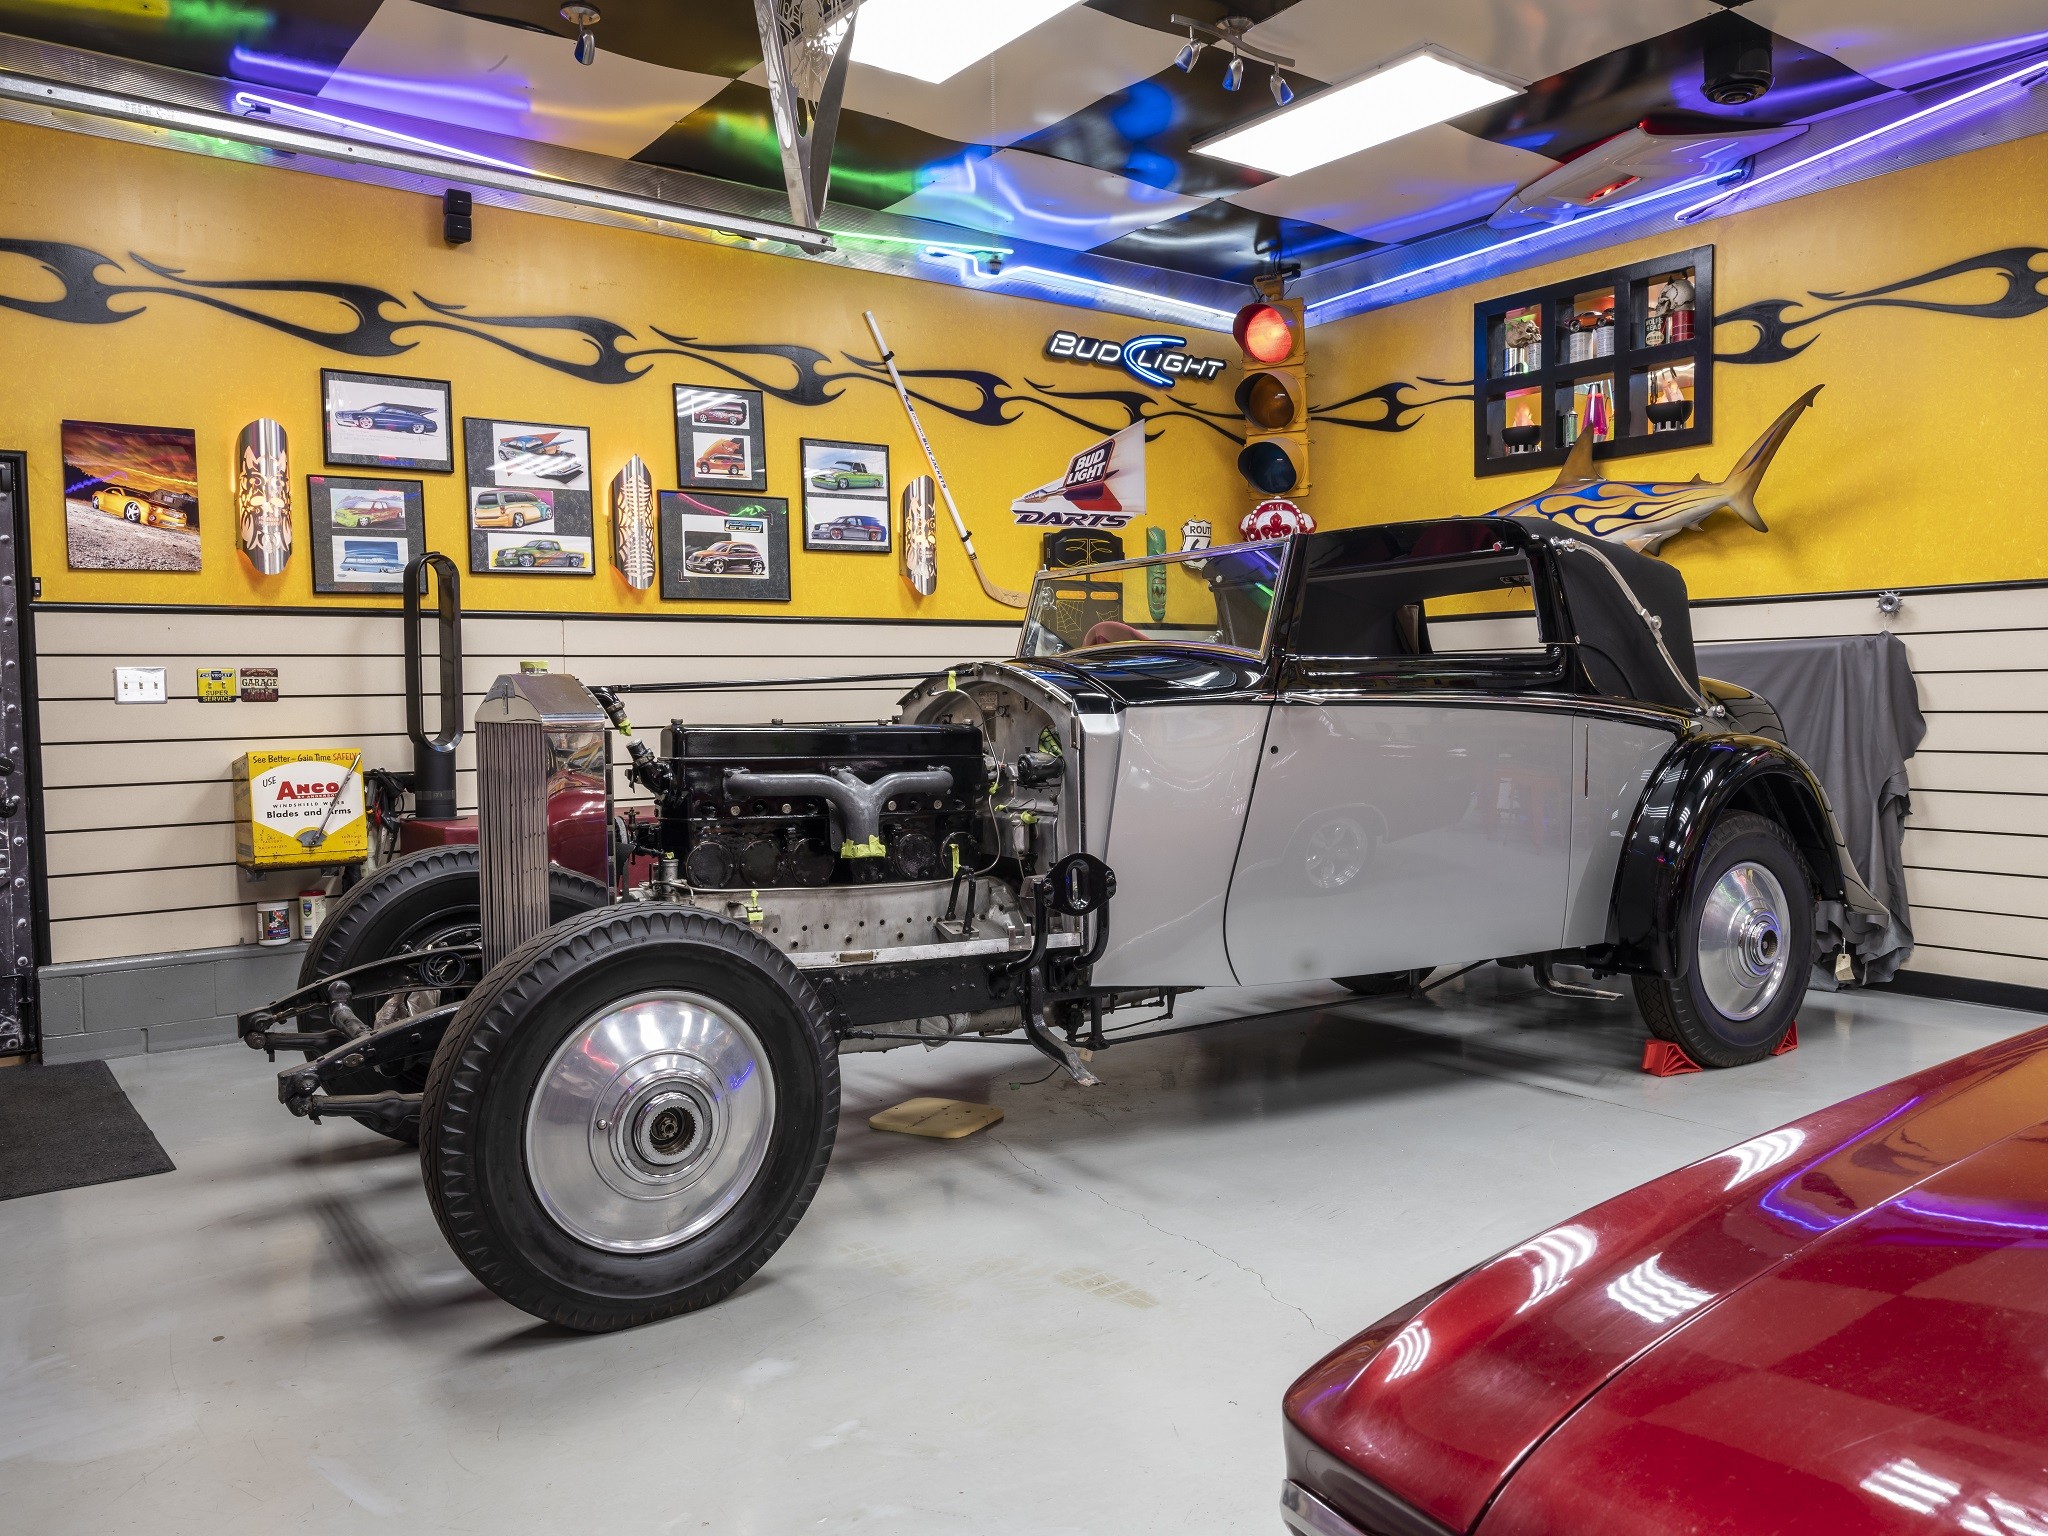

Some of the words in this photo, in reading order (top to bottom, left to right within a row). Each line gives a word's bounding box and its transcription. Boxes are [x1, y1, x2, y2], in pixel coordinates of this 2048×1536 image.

[1050, 333, 1121, 362] BUD
[1137, 349, 1224, 377] LIGHT
[1074, 448, 1105, 472] BUD
[930, 456, 947, 489] JACKETS
[1067, 461, 1106, 483] LIGHT
[1011, 509, 1133, 528] DARTS
[241, 679, 278, 687] GARAGE
[252, 756, 266, 764] See
[297, 754, 313, 762] Gain
[314, 753, 331, 761] Time
[262, 776, 277, 788] USE
[276, 781, 340, 800] ANCO
[266, 810, 299, 819] Blades
[303, 808, 322, 816] and
